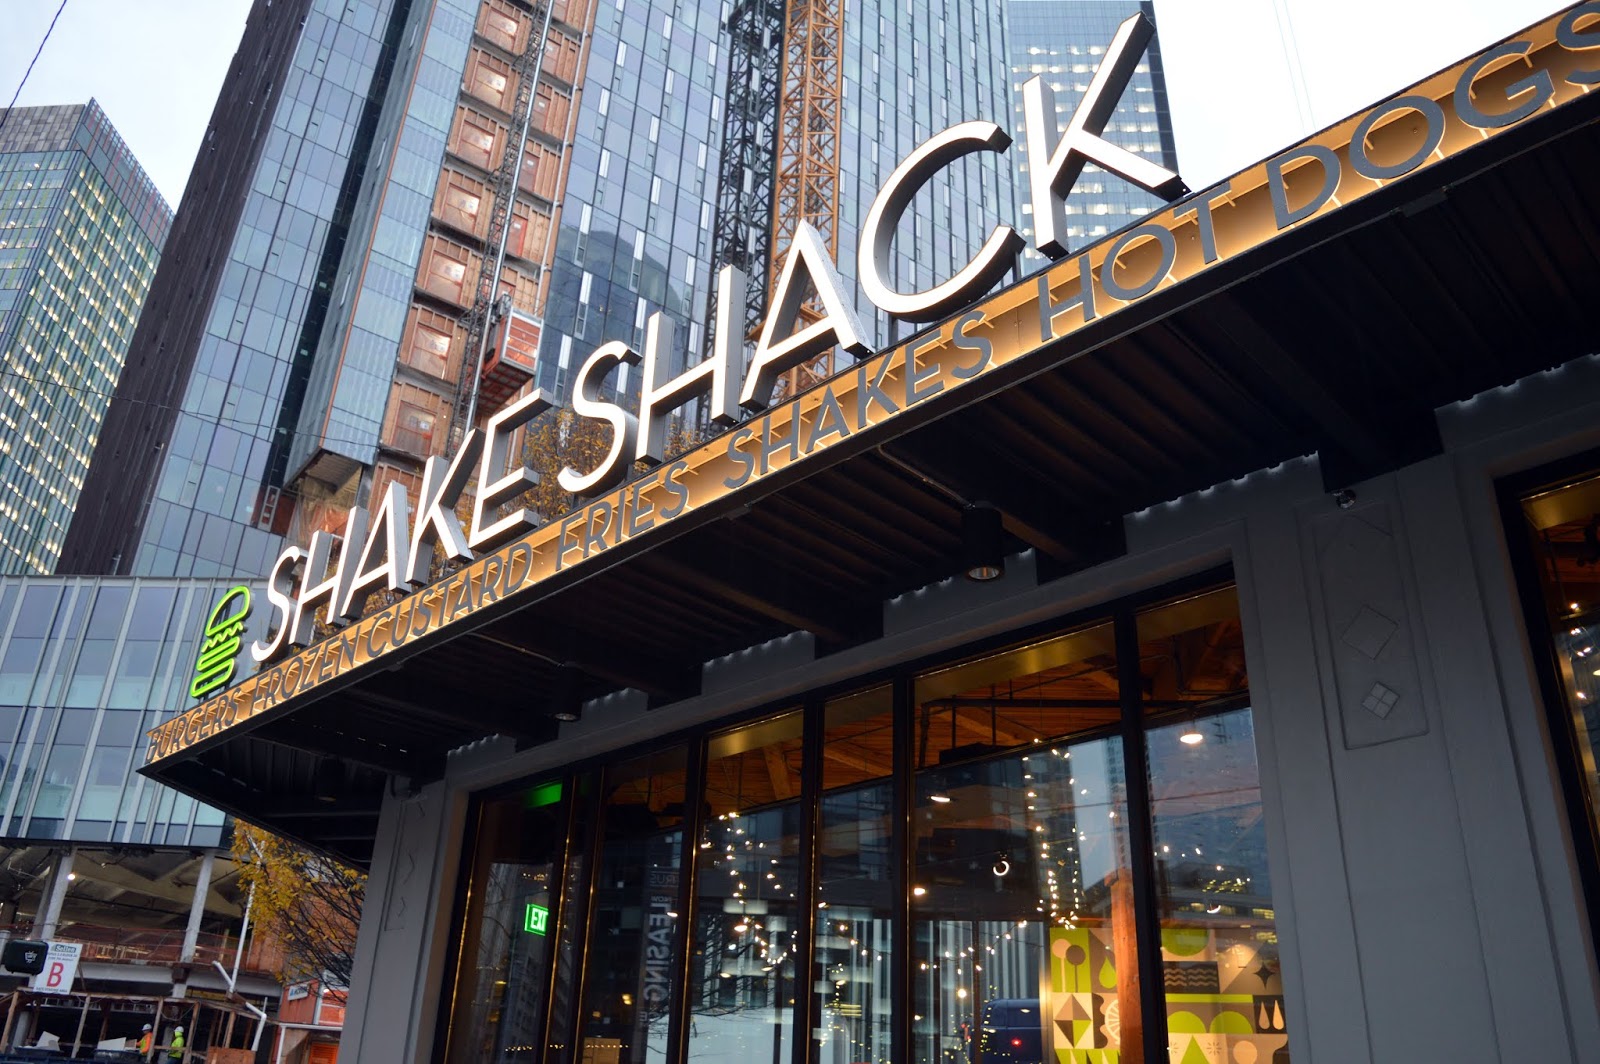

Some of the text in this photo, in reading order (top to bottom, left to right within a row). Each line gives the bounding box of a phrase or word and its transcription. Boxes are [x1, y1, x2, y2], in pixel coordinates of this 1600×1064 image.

[146, 1, 1600, 765] BURGERS FROZEN CUSTARD FRIES SHAKES HOT DOGS
[251, 12, 1191, 662] SHAKE SHACK
[46, 962, 64, 987] B
